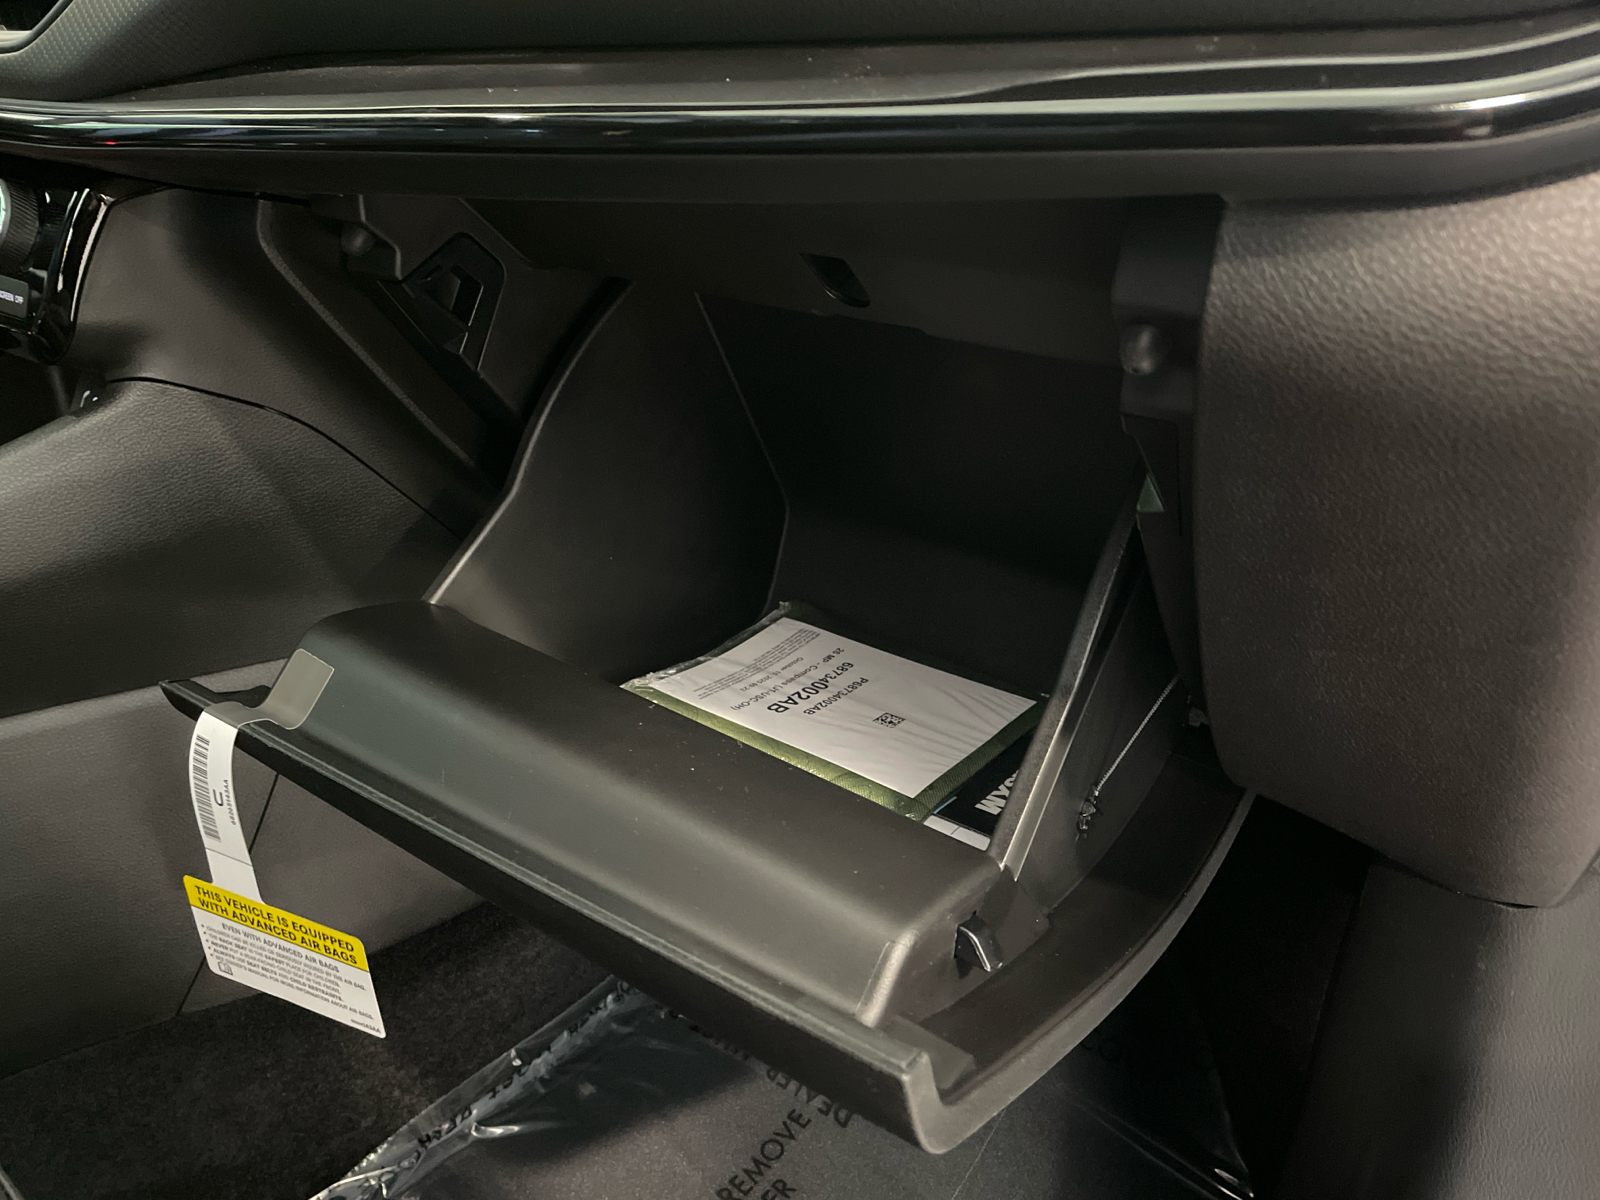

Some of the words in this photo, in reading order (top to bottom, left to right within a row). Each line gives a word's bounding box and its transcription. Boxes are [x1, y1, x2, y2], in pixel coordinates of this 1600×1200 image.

[782, 665, 818, 686] Compass
[822, 653, 835, 664] MP
[767, 662, 854, 713] 68734002AB
[803, 677, 869, 715] P68734002AB
[195, 886, 221, 902] THIS
[224, 896, 274, 921] VEHICLE
[276, 916, 288, 927] IS
[291, 922, 354, 952] EQUIPPED
[198, 898, 228, 915] WITH
[231, 910, 296, 940] ADVANCED
[300, 936, 320, 950] AIR
[323, 945, 356, 964] BAGS
[221, 923, 240, 935] EVEN
[242, 931, 261, 942] WITH
[263, 939, 302, 958] ADVANCED
[304, 954, 317, 964] AIR
[318, 960, 339, 972] BAGS
[715, 1108, 812, 1200] REMOVE
